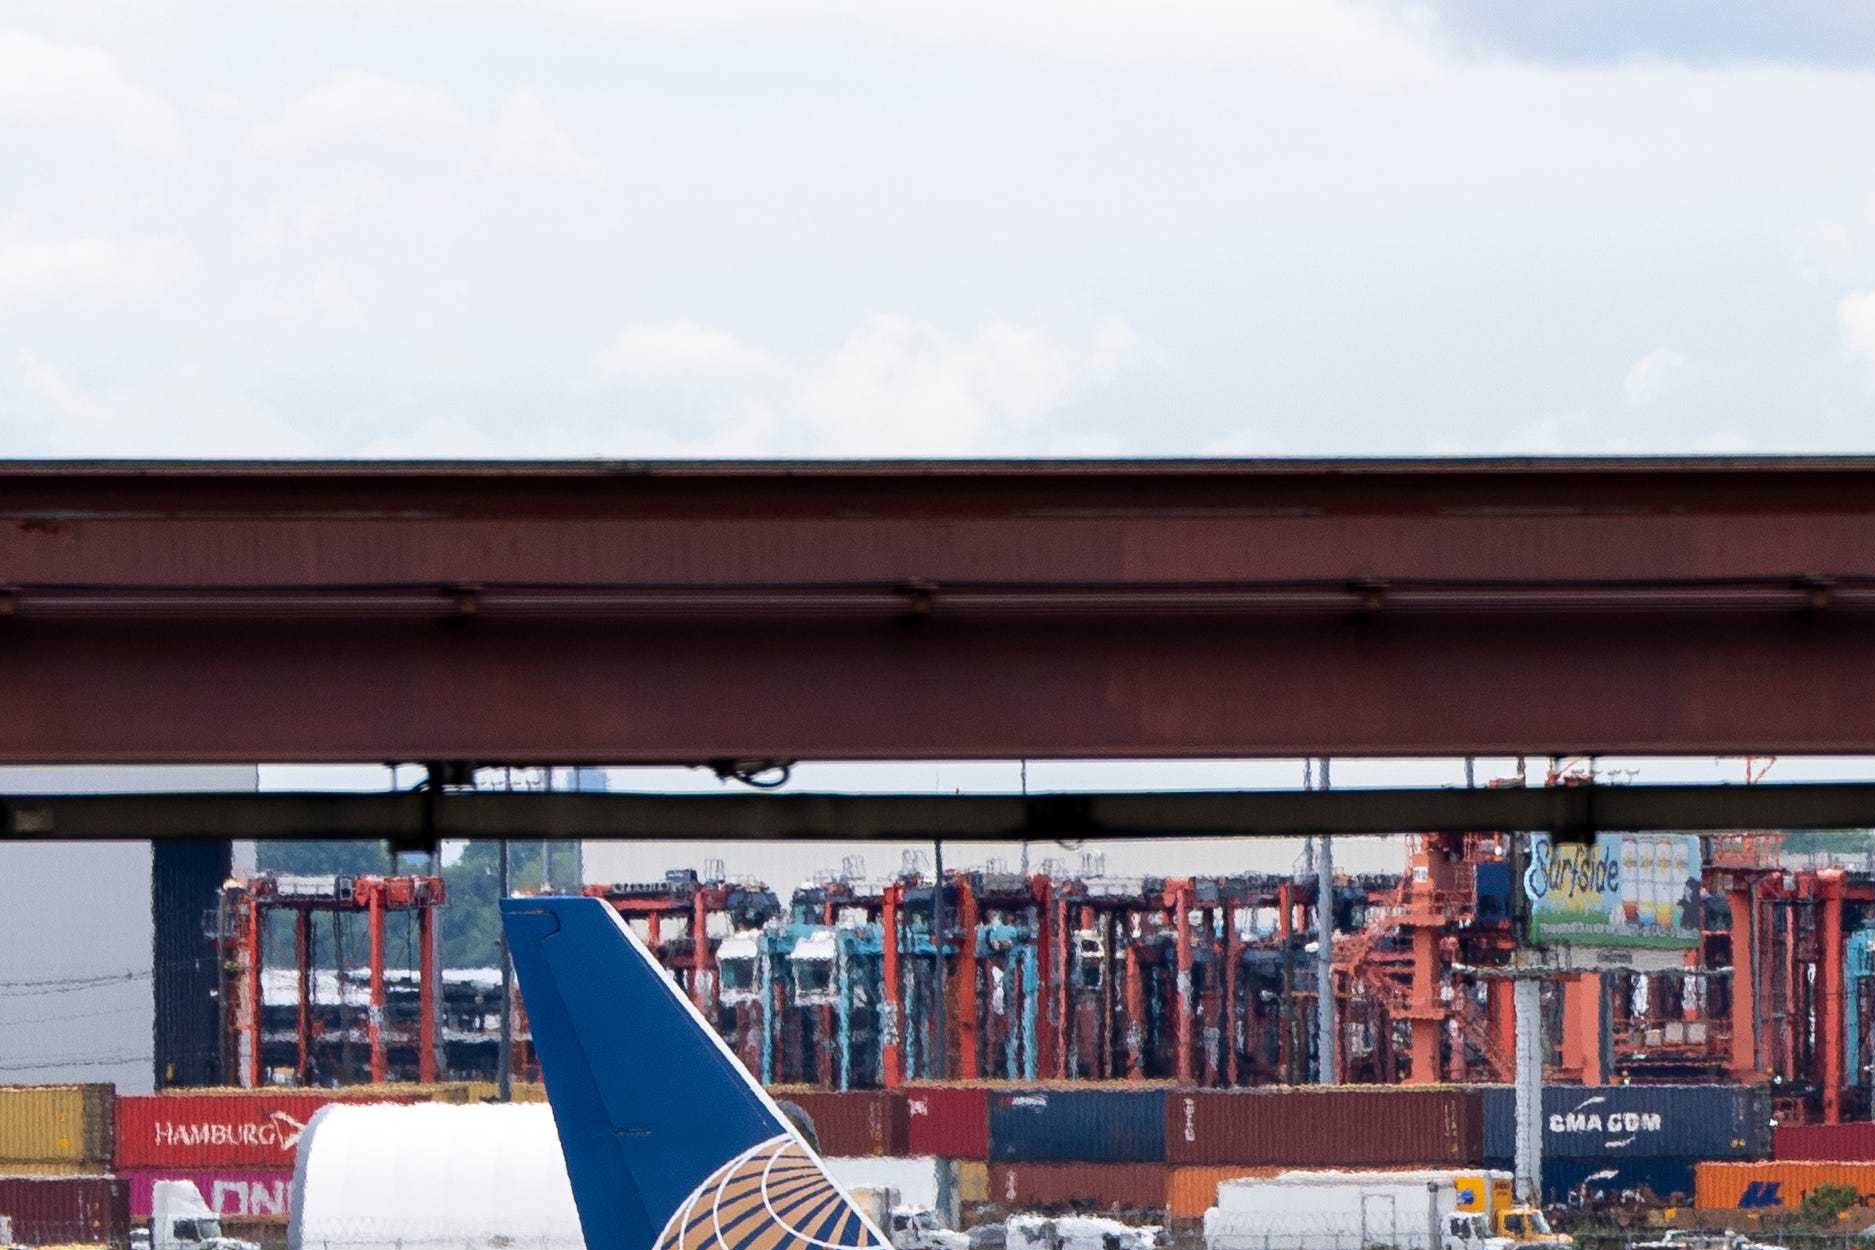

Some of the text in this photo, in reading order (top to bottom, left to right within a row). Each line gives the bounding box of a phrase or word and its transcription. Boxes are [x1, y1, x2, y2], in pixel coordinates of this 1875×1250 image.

[1529, 840, 1620, 898] Surfside
[155, 1122, 275, 1146] HAMBURG
[212, 1179, 291, 1215] ON
